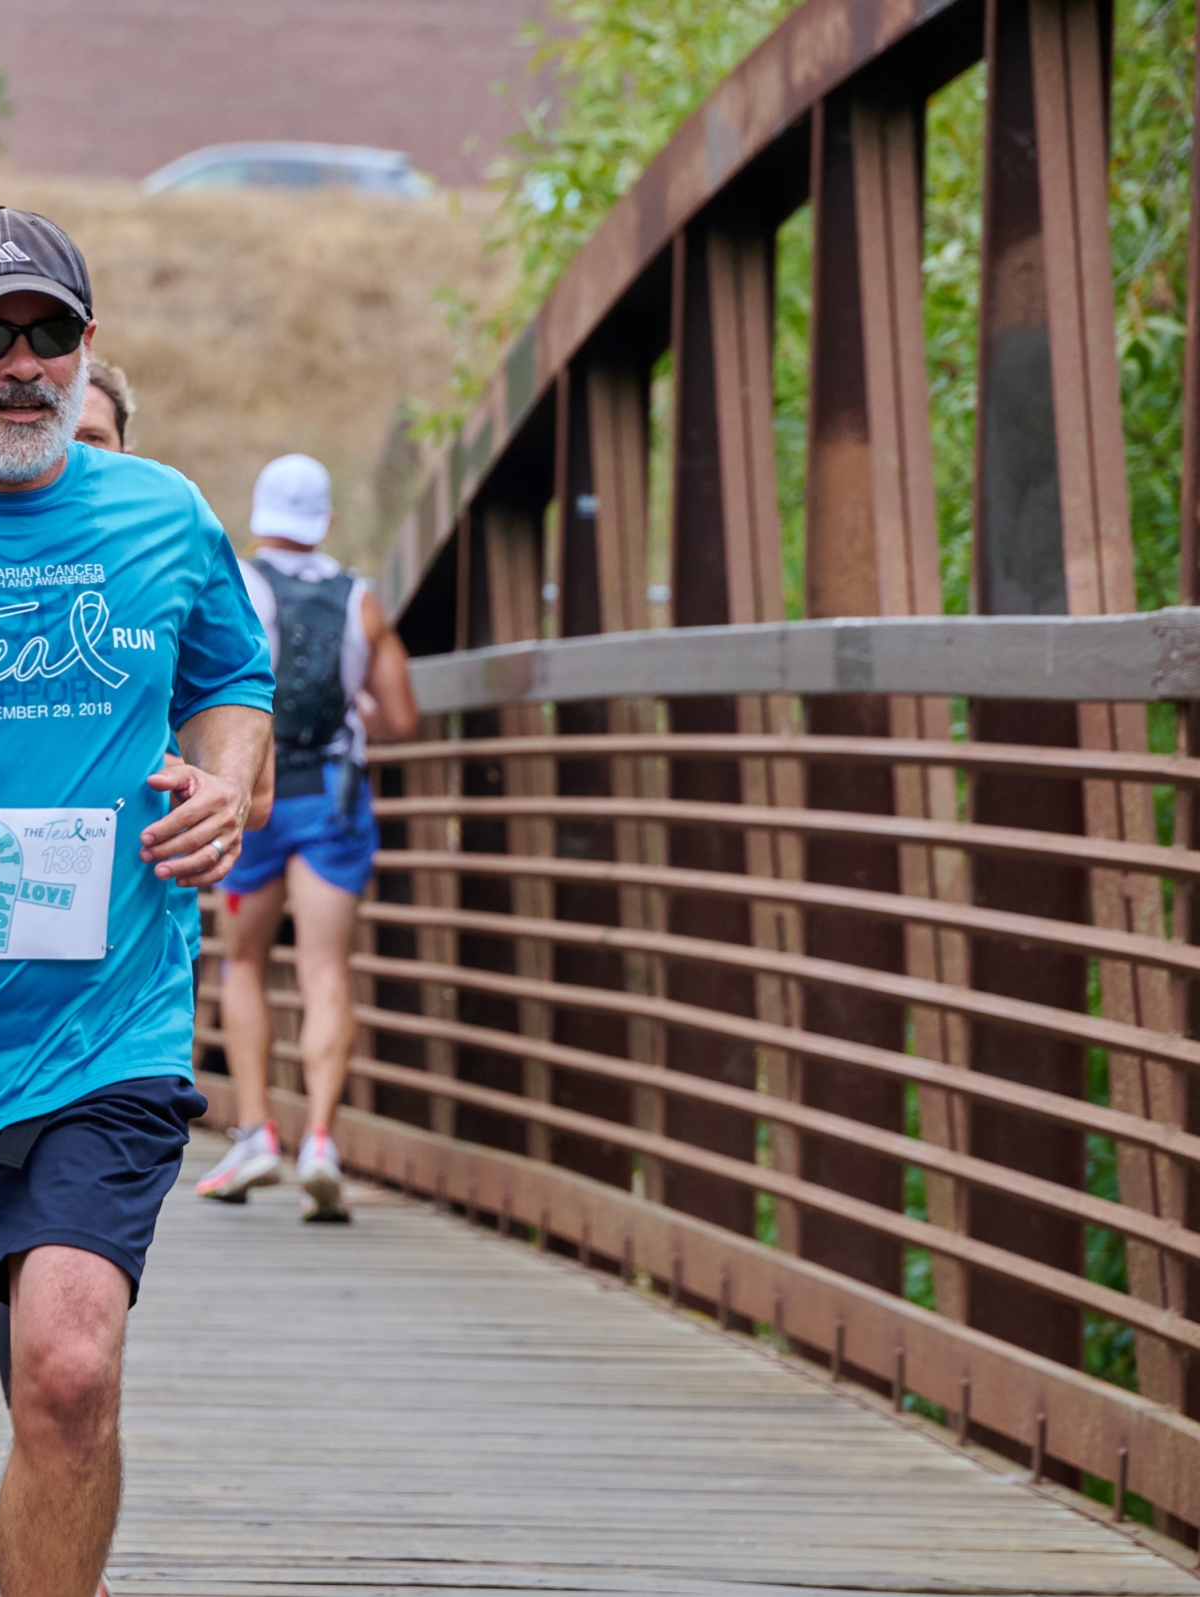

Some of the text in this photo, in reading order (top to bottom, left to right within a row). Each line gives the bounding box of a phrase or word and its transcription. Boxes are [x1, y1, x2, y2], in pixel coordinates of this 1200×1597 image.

[7, 577, 33, 588] AND
[35, 574, 106, 587] AWARENESS
[42, 564, 104, 578] CANCER
[112, 627, 156, 651] RUN
[52, 703, 75, 719] 29,
[78, 701, 113, 717] 2018
[23, 818, 107, 842] THE Teal RUN
[41, 845, 93, 874] 138
[20, 882, 71, 906] LOVE
